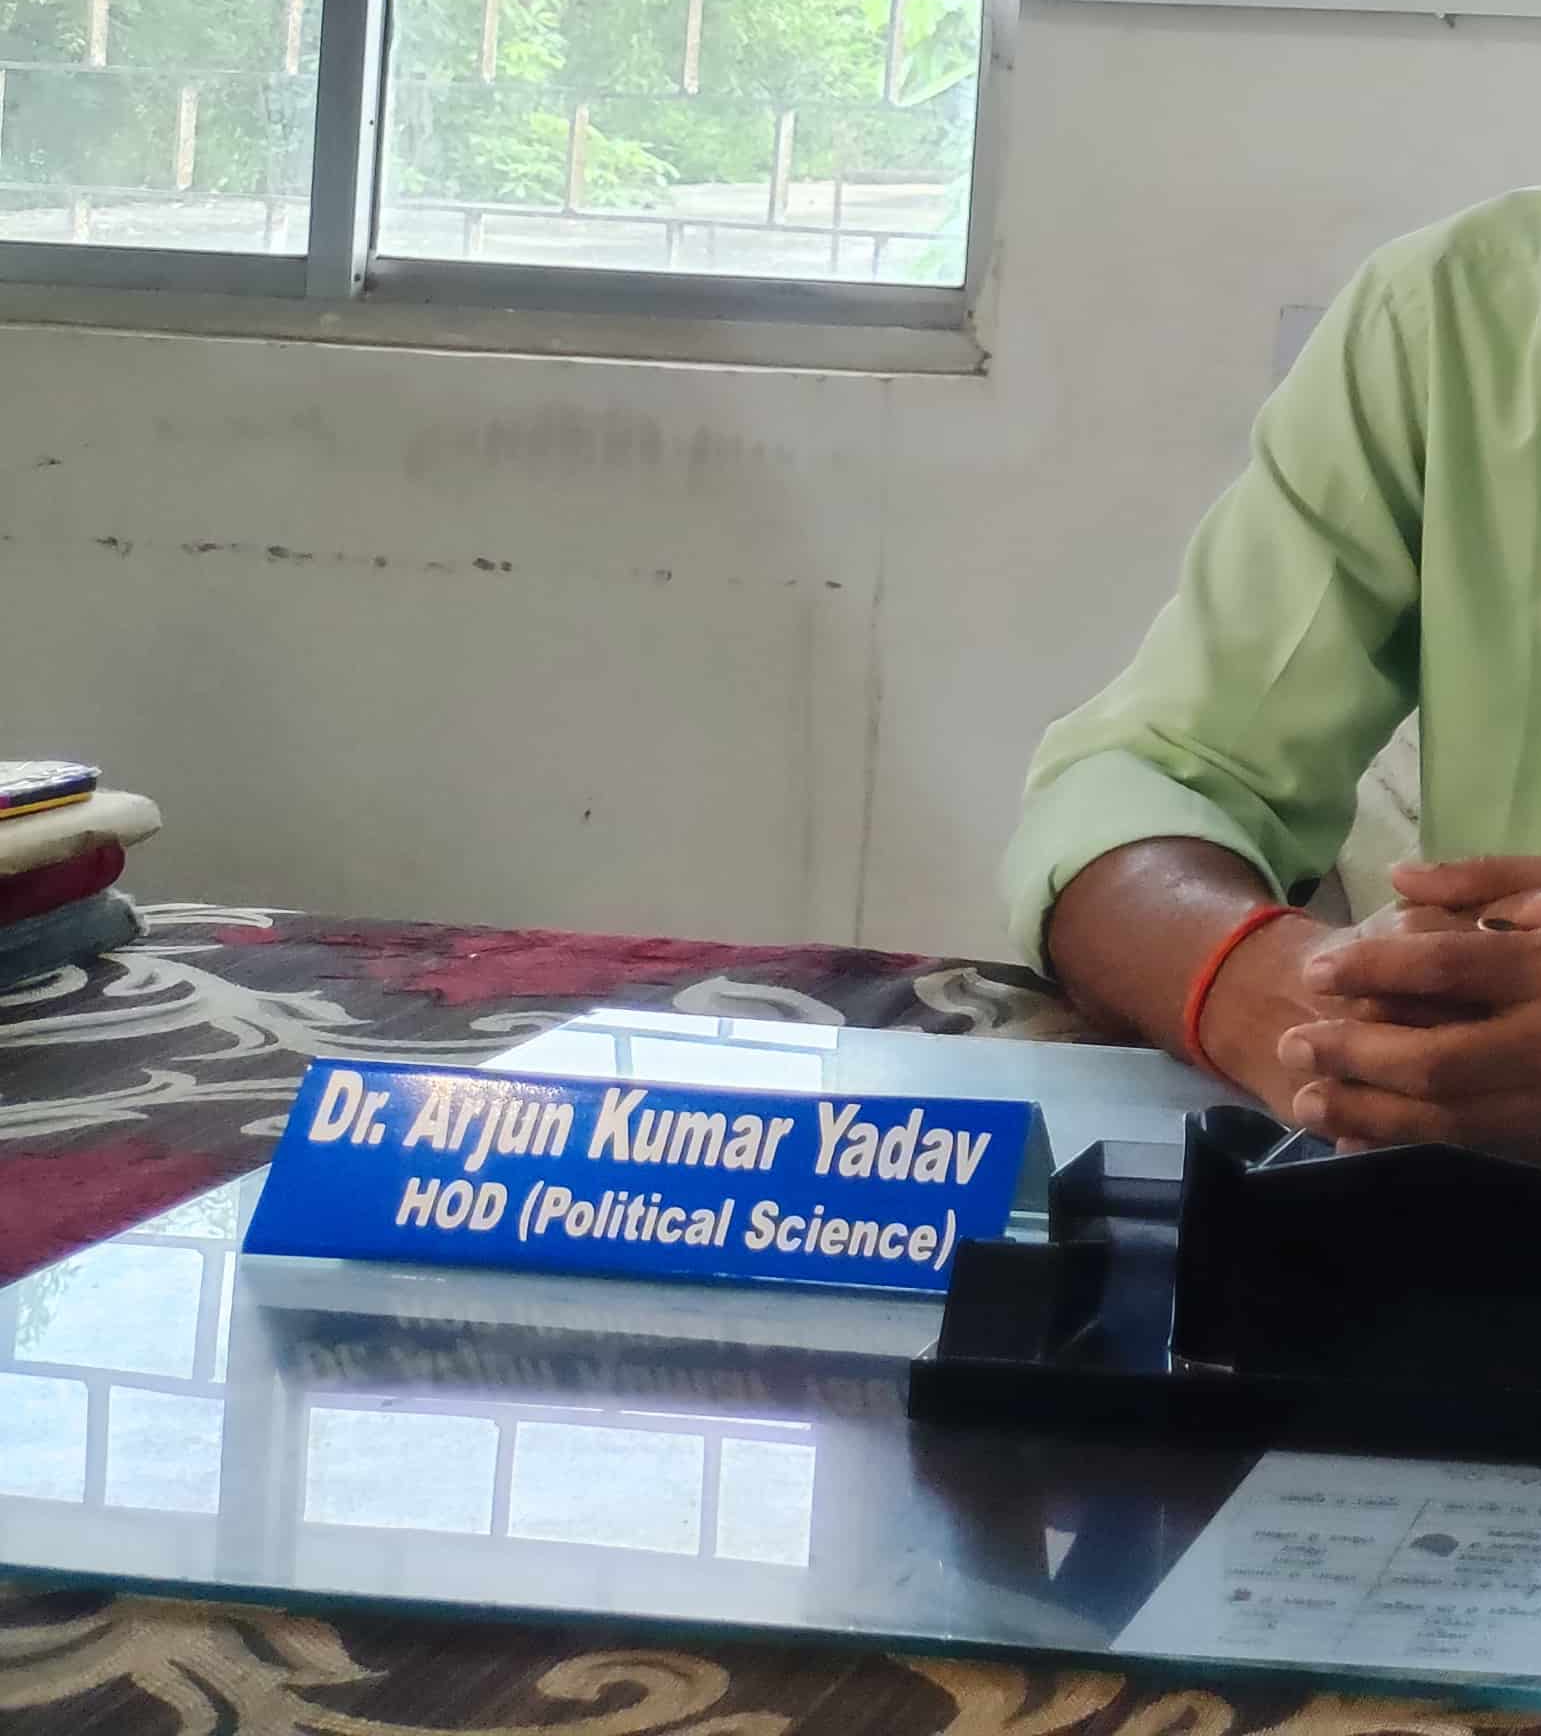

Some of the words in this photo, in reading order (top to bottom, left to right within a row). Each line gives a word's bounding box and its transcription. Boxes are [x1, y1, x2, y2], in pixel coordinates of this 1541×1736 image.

[309, 1070, 386, 1145] Dr.
[402, 1089, 573, 1172] Arjun
[588, 1086, 792, 1170] Kumar
[815, 1102, 991, 1184] Yadav
[396, 1178, 507, 1230] HOD
[519, 1181, 734, 1246] (Political
[745, 1201, 955, 1270] Science)
